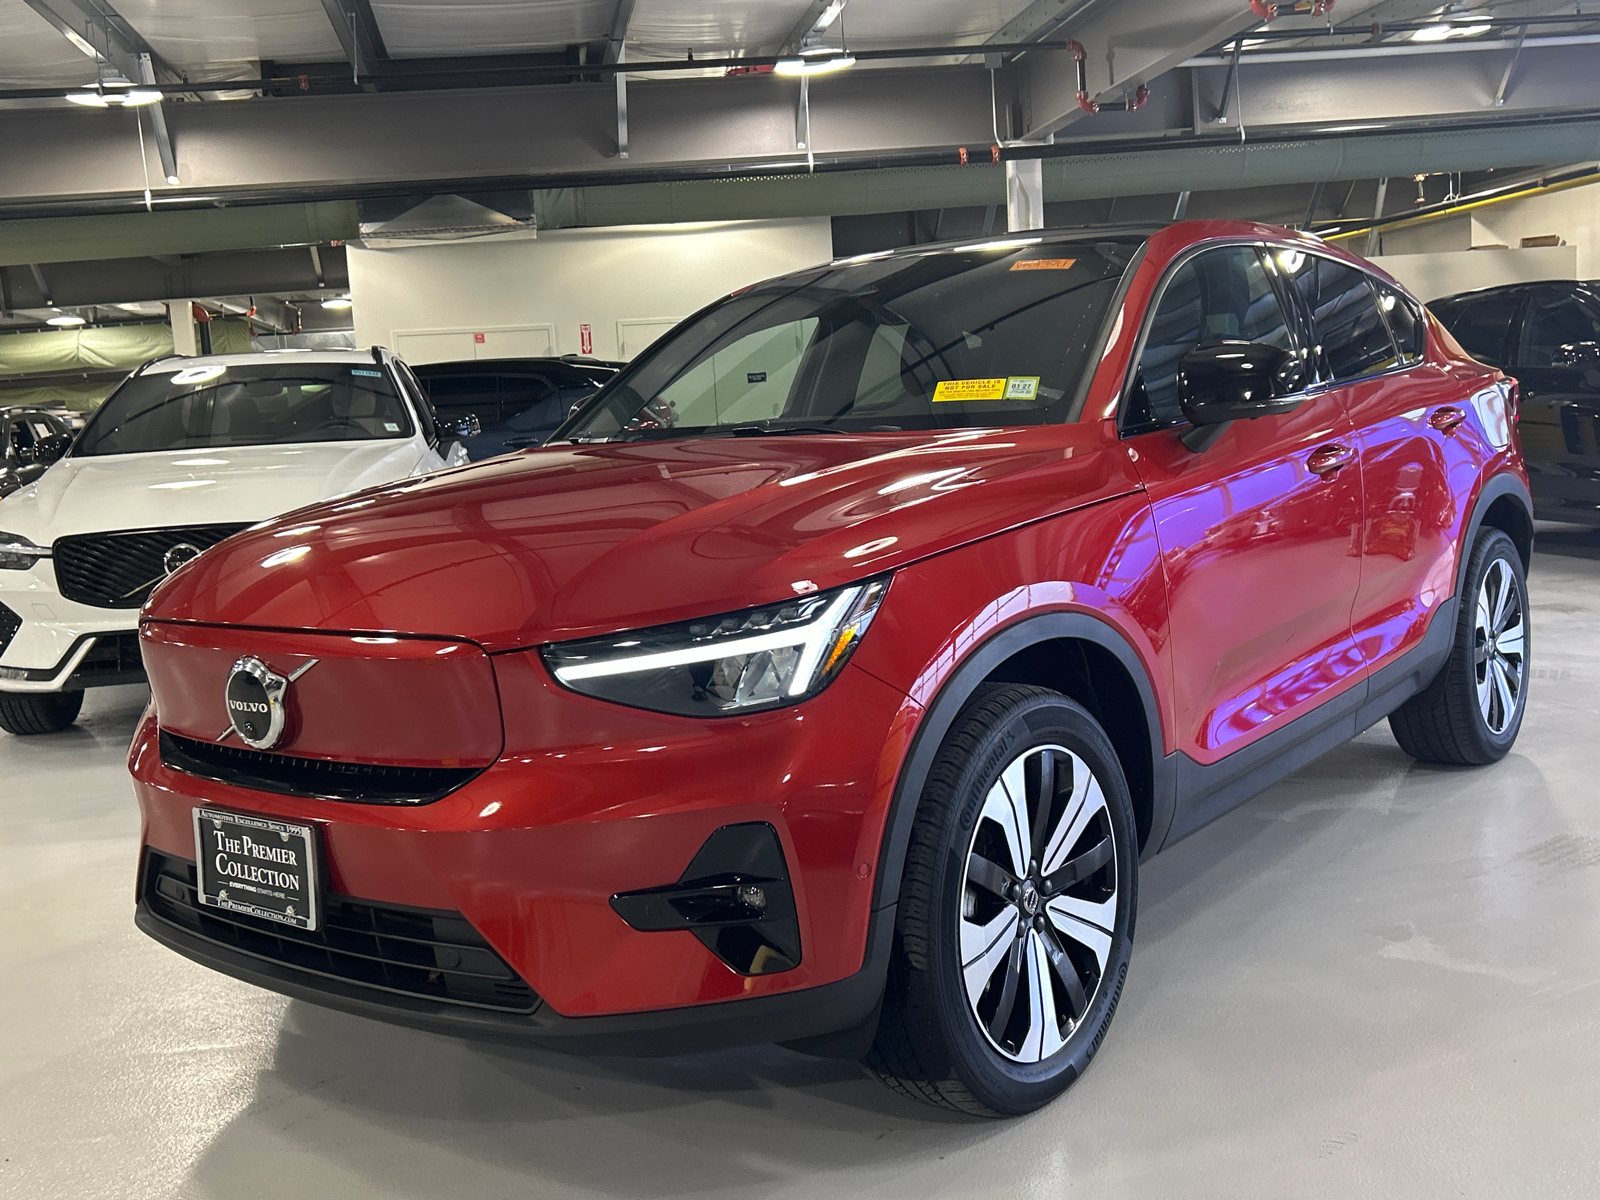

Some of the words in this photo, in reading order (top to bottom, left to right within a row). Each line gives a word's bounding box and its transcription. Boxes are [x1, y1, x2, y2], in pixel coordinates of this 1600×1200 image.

[228, 699, 268, 713] VOLVO
[213, 830, 242, 854] THE
[242, 835, 298, 866] PREMIER
[215, 853, 300, 891] COLLECTION
[229, 881, 257, 893] EVERYTHING
